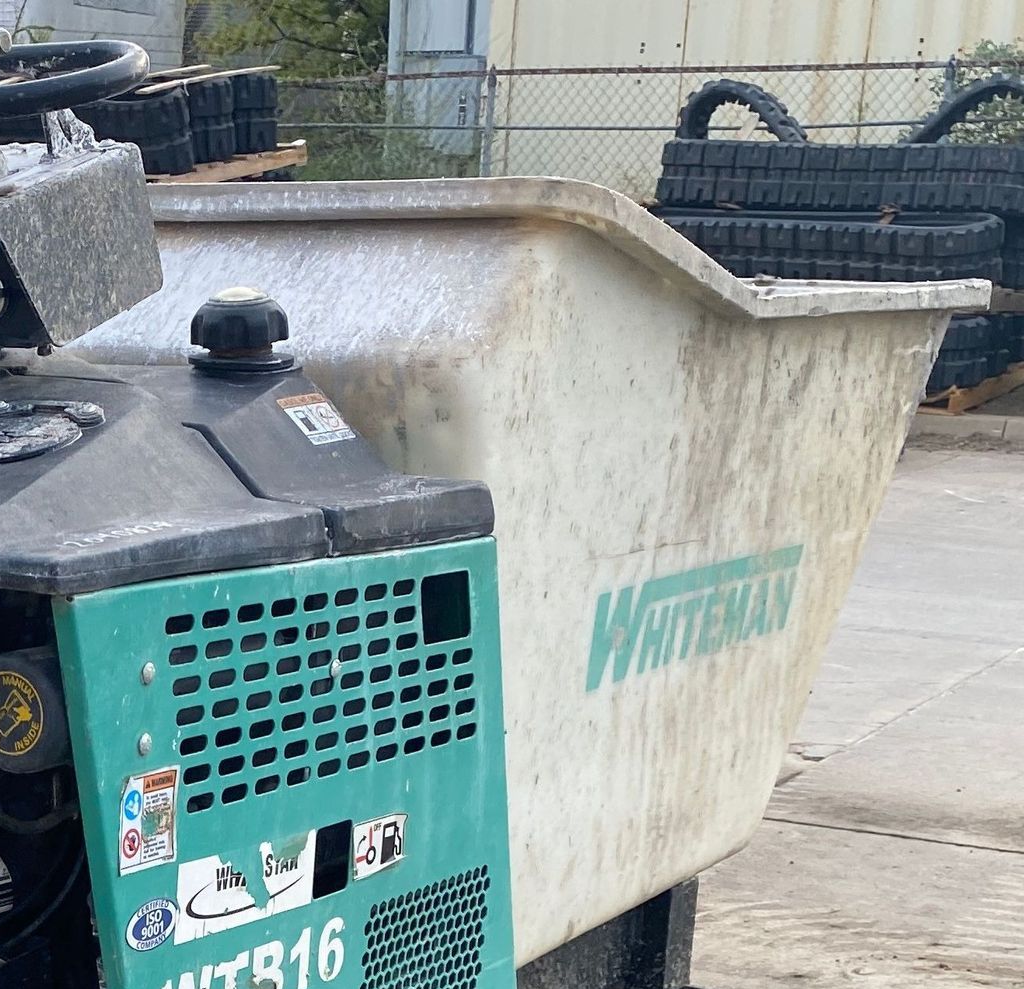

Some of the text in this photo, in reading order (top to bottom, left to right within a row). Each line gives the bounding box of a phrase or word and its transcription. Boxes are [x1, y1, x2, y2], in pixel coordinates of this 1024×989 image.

[585, 544, 804, 692] WHITEMAN
[2, 676, 36, 702] MANUAL
[14, 721, 40, 751] INSIDE
[373, 822, 382, 832] OFF
[136, 899, 170, 919] CERTIFIED
[145, 909, 163, 927] ISO
[141, 920, 164, 941] 9001
[136, 933, 167, 950] COMPANY
